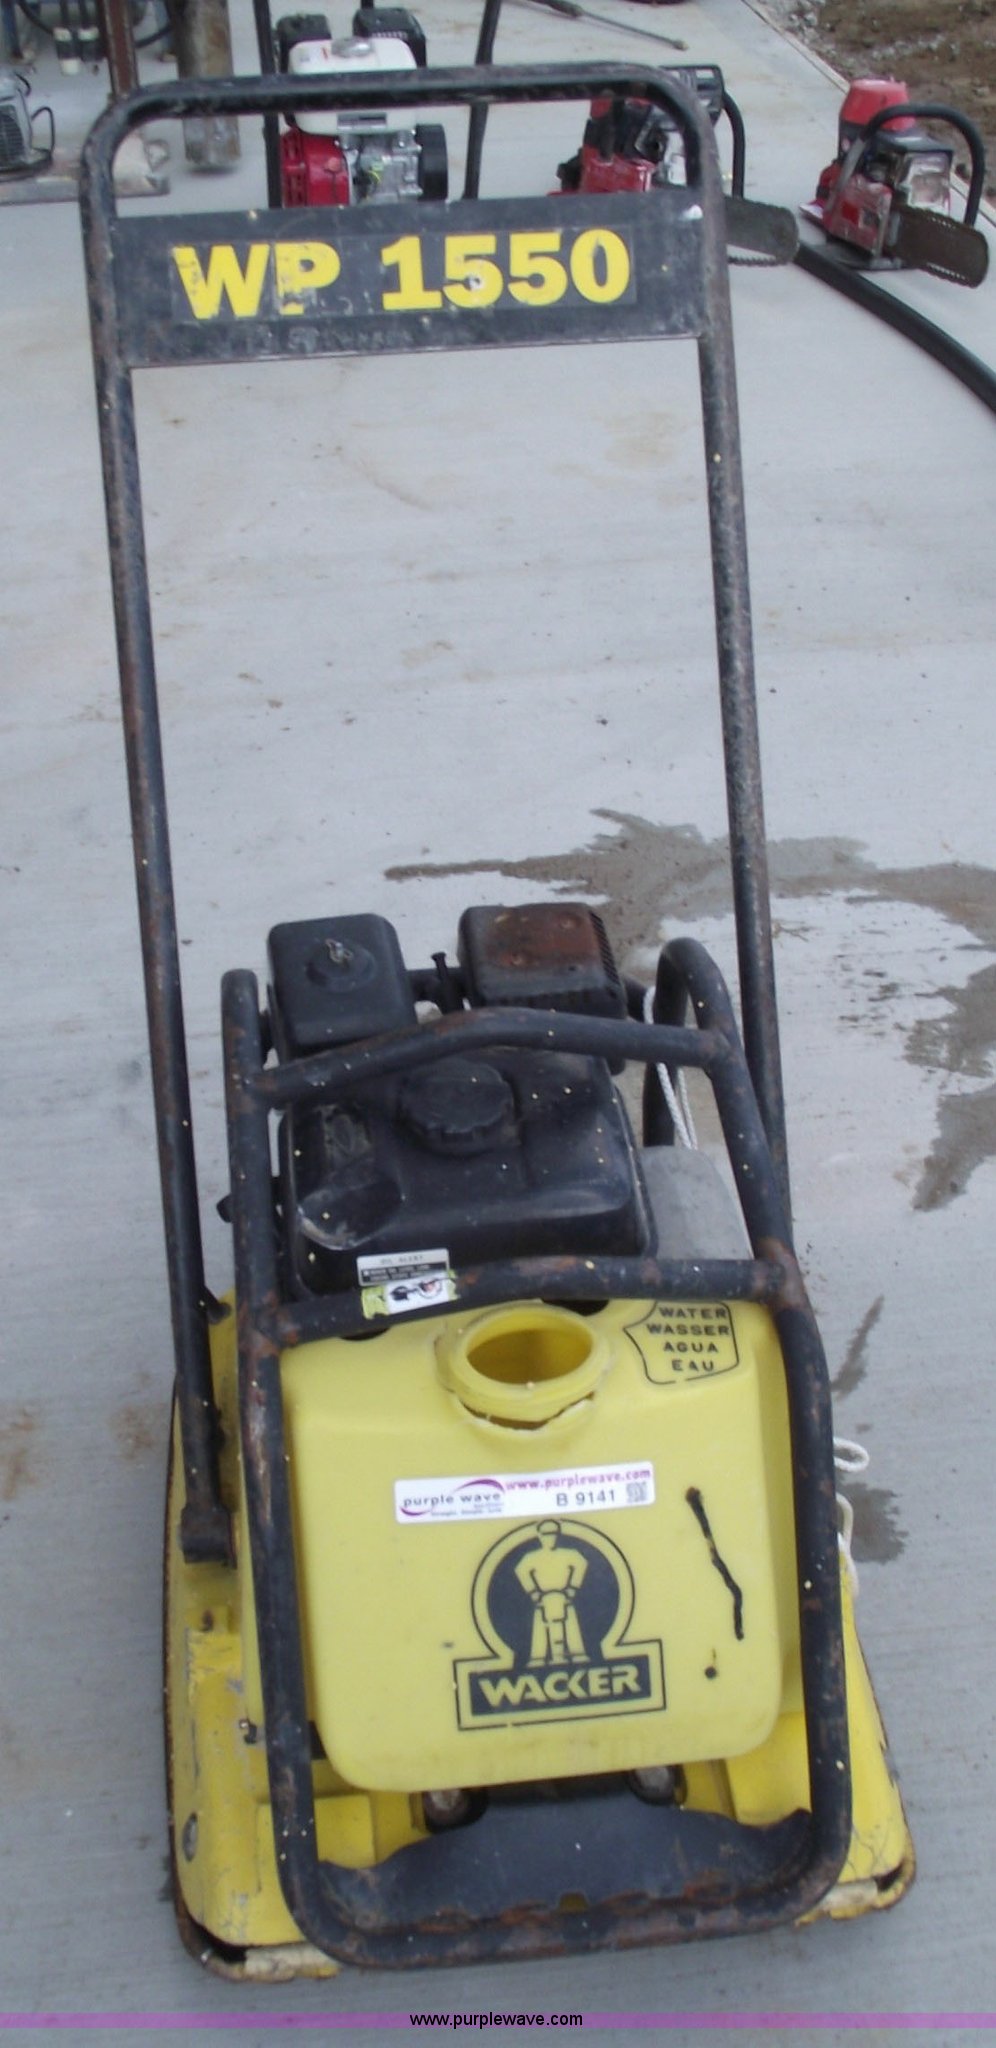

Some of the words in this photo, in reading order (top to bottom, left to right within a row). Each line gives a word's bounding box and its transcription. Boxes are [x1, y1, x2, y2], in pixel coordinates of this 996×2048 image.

[172, 240, 341, 320] WP
[381, 228, 631, 312] 1550
[659, 1306, 728, 1319] WATER
[646, 1323, 730, 1336] WASSER
[663, 1341, 719, 1353] AGUA
[671, 1359, 715, 1372] EAU
[505, 1468, 651, 1491] www.purplewave.com
[403, 1493, 454, 1508] purple
[460, 1493, 501, 1502] wave
[556, 1492, 569, 1507] B
[575, 1489, 616, 1506] 9141
[477, 1664, 642, 1708] WACKER
